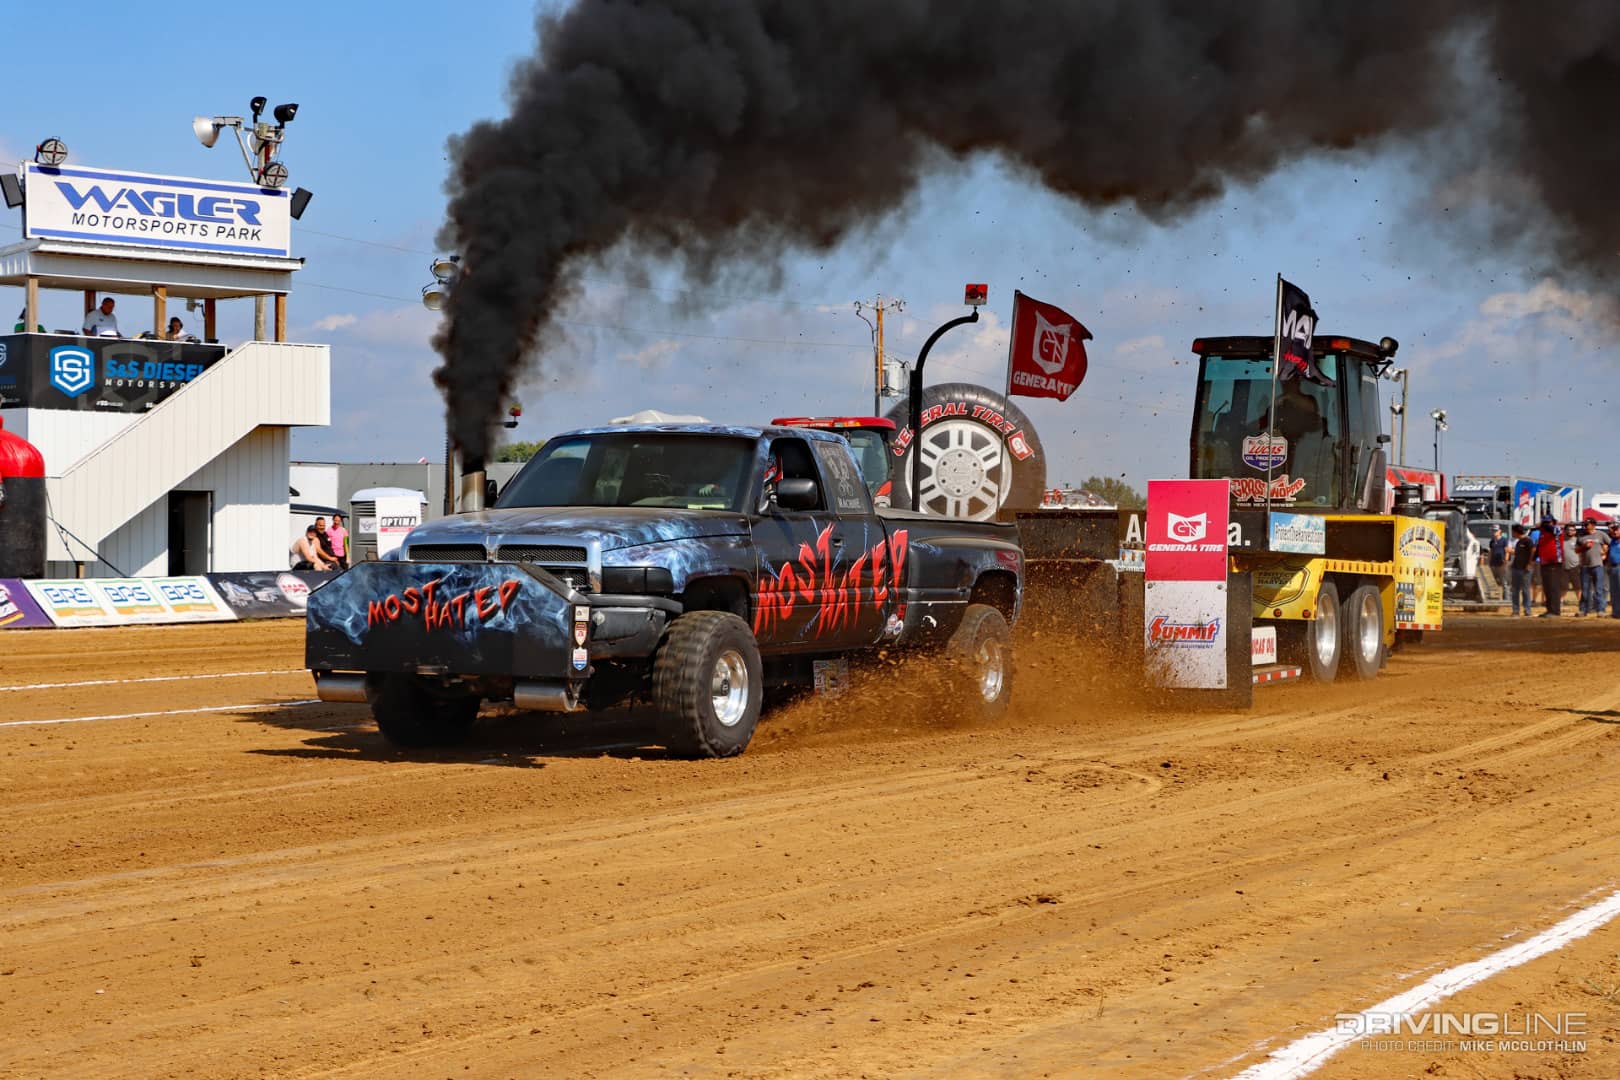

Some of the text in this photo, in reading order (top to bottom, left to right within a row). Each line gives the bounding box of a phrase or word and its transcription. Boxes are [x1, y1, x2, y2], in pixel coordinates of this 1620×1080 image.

[54, 181, 263, 226] WAGLER
[72, 212, 262, 242] MOTORSPORTS PARK
[105, 359, 139, 379] S&S
[973, 406, 1016, 434] TIRE
[381, 516, 416, 527] OPTIMA
[1148, 543, 1225, 552] GENERAL TIRE
[753, 522, 836, 640] MOST
[367, 578, 441, 629] MOST
